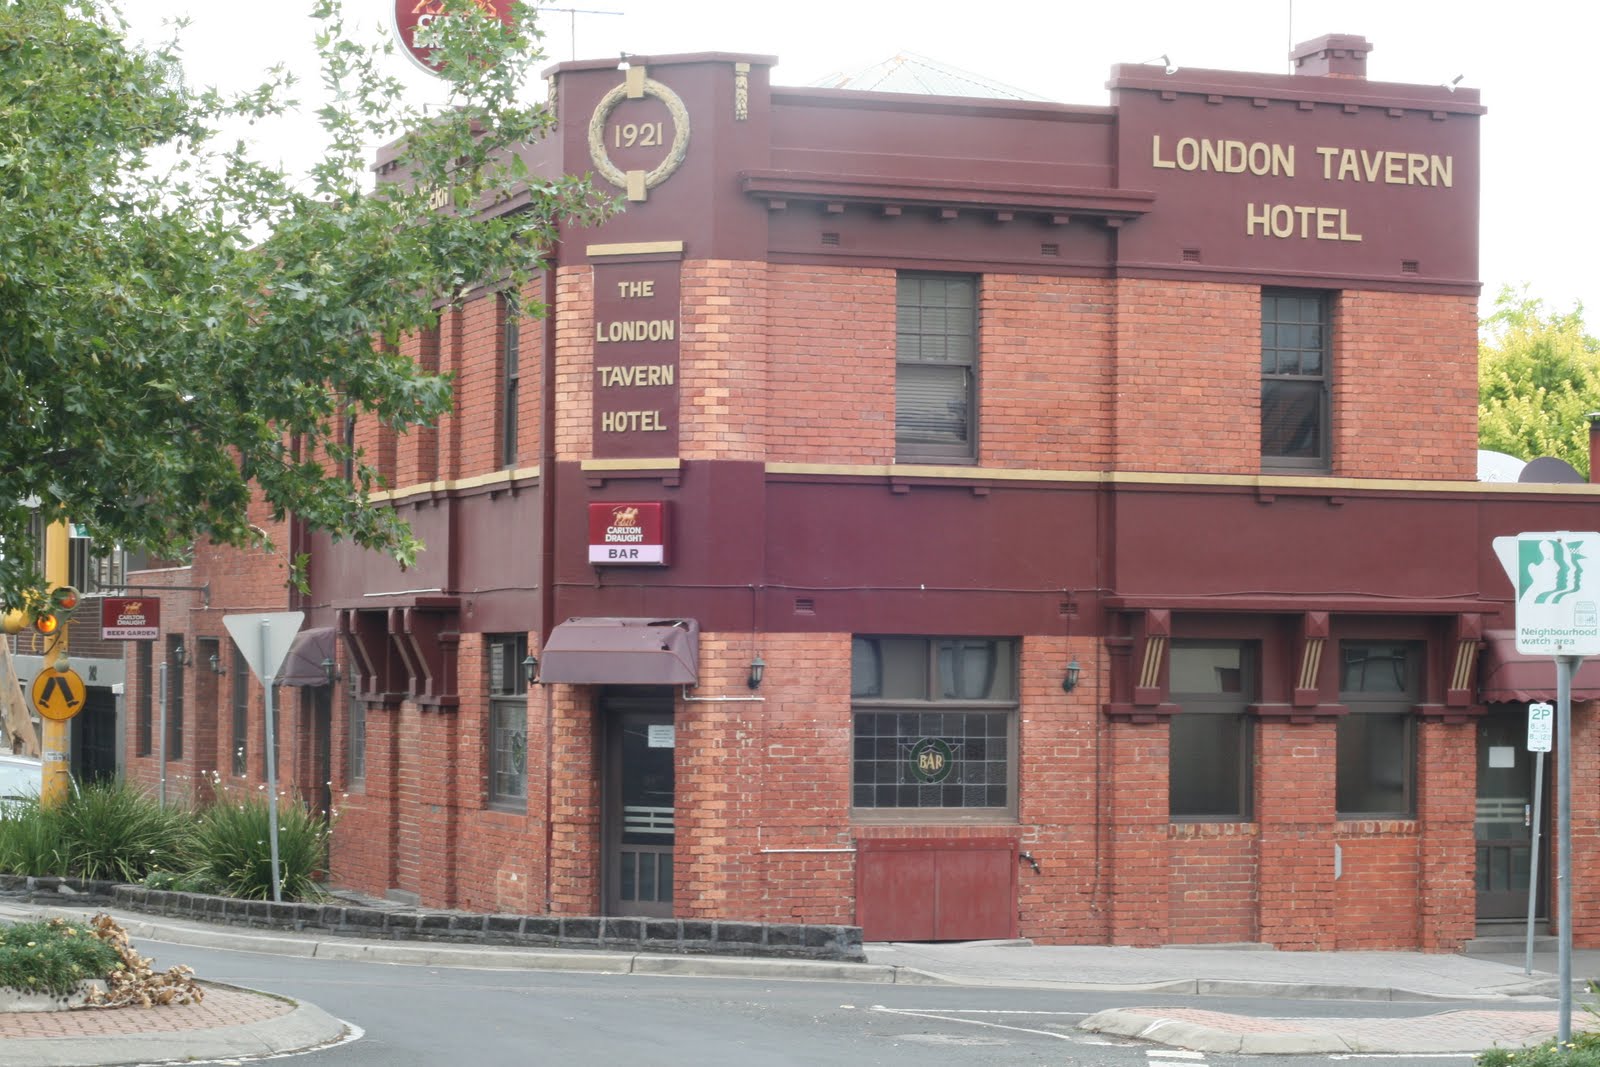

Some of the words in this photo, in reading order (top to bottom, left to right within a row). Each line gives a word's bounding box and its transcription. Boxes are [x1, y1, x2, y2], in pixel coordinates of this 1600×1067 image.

[615, 122, 663, 148] 1921
[1152, 135, 1295, 178] LONDON
[1316, 146, 1453, 187] TAVERN
[1247, 203, 1362, 242] HOTEL
[618, 281, 654, 298] THE
[596, 320, 674, 342] LONDON
[597, 364, 674, 387] TAVERN
[602, 410, 667, 432] HOTEL
[605, 534, 643, 542] DRAUGHT
[607, 526, 642, 534] CARLTON
[608, 549, 639, 559] BAR
[1521, 628, 1597, 638] Neighbourhood
[1532, 708, 1551, 720] 2P
[919, 752, 943, 770] BAR
